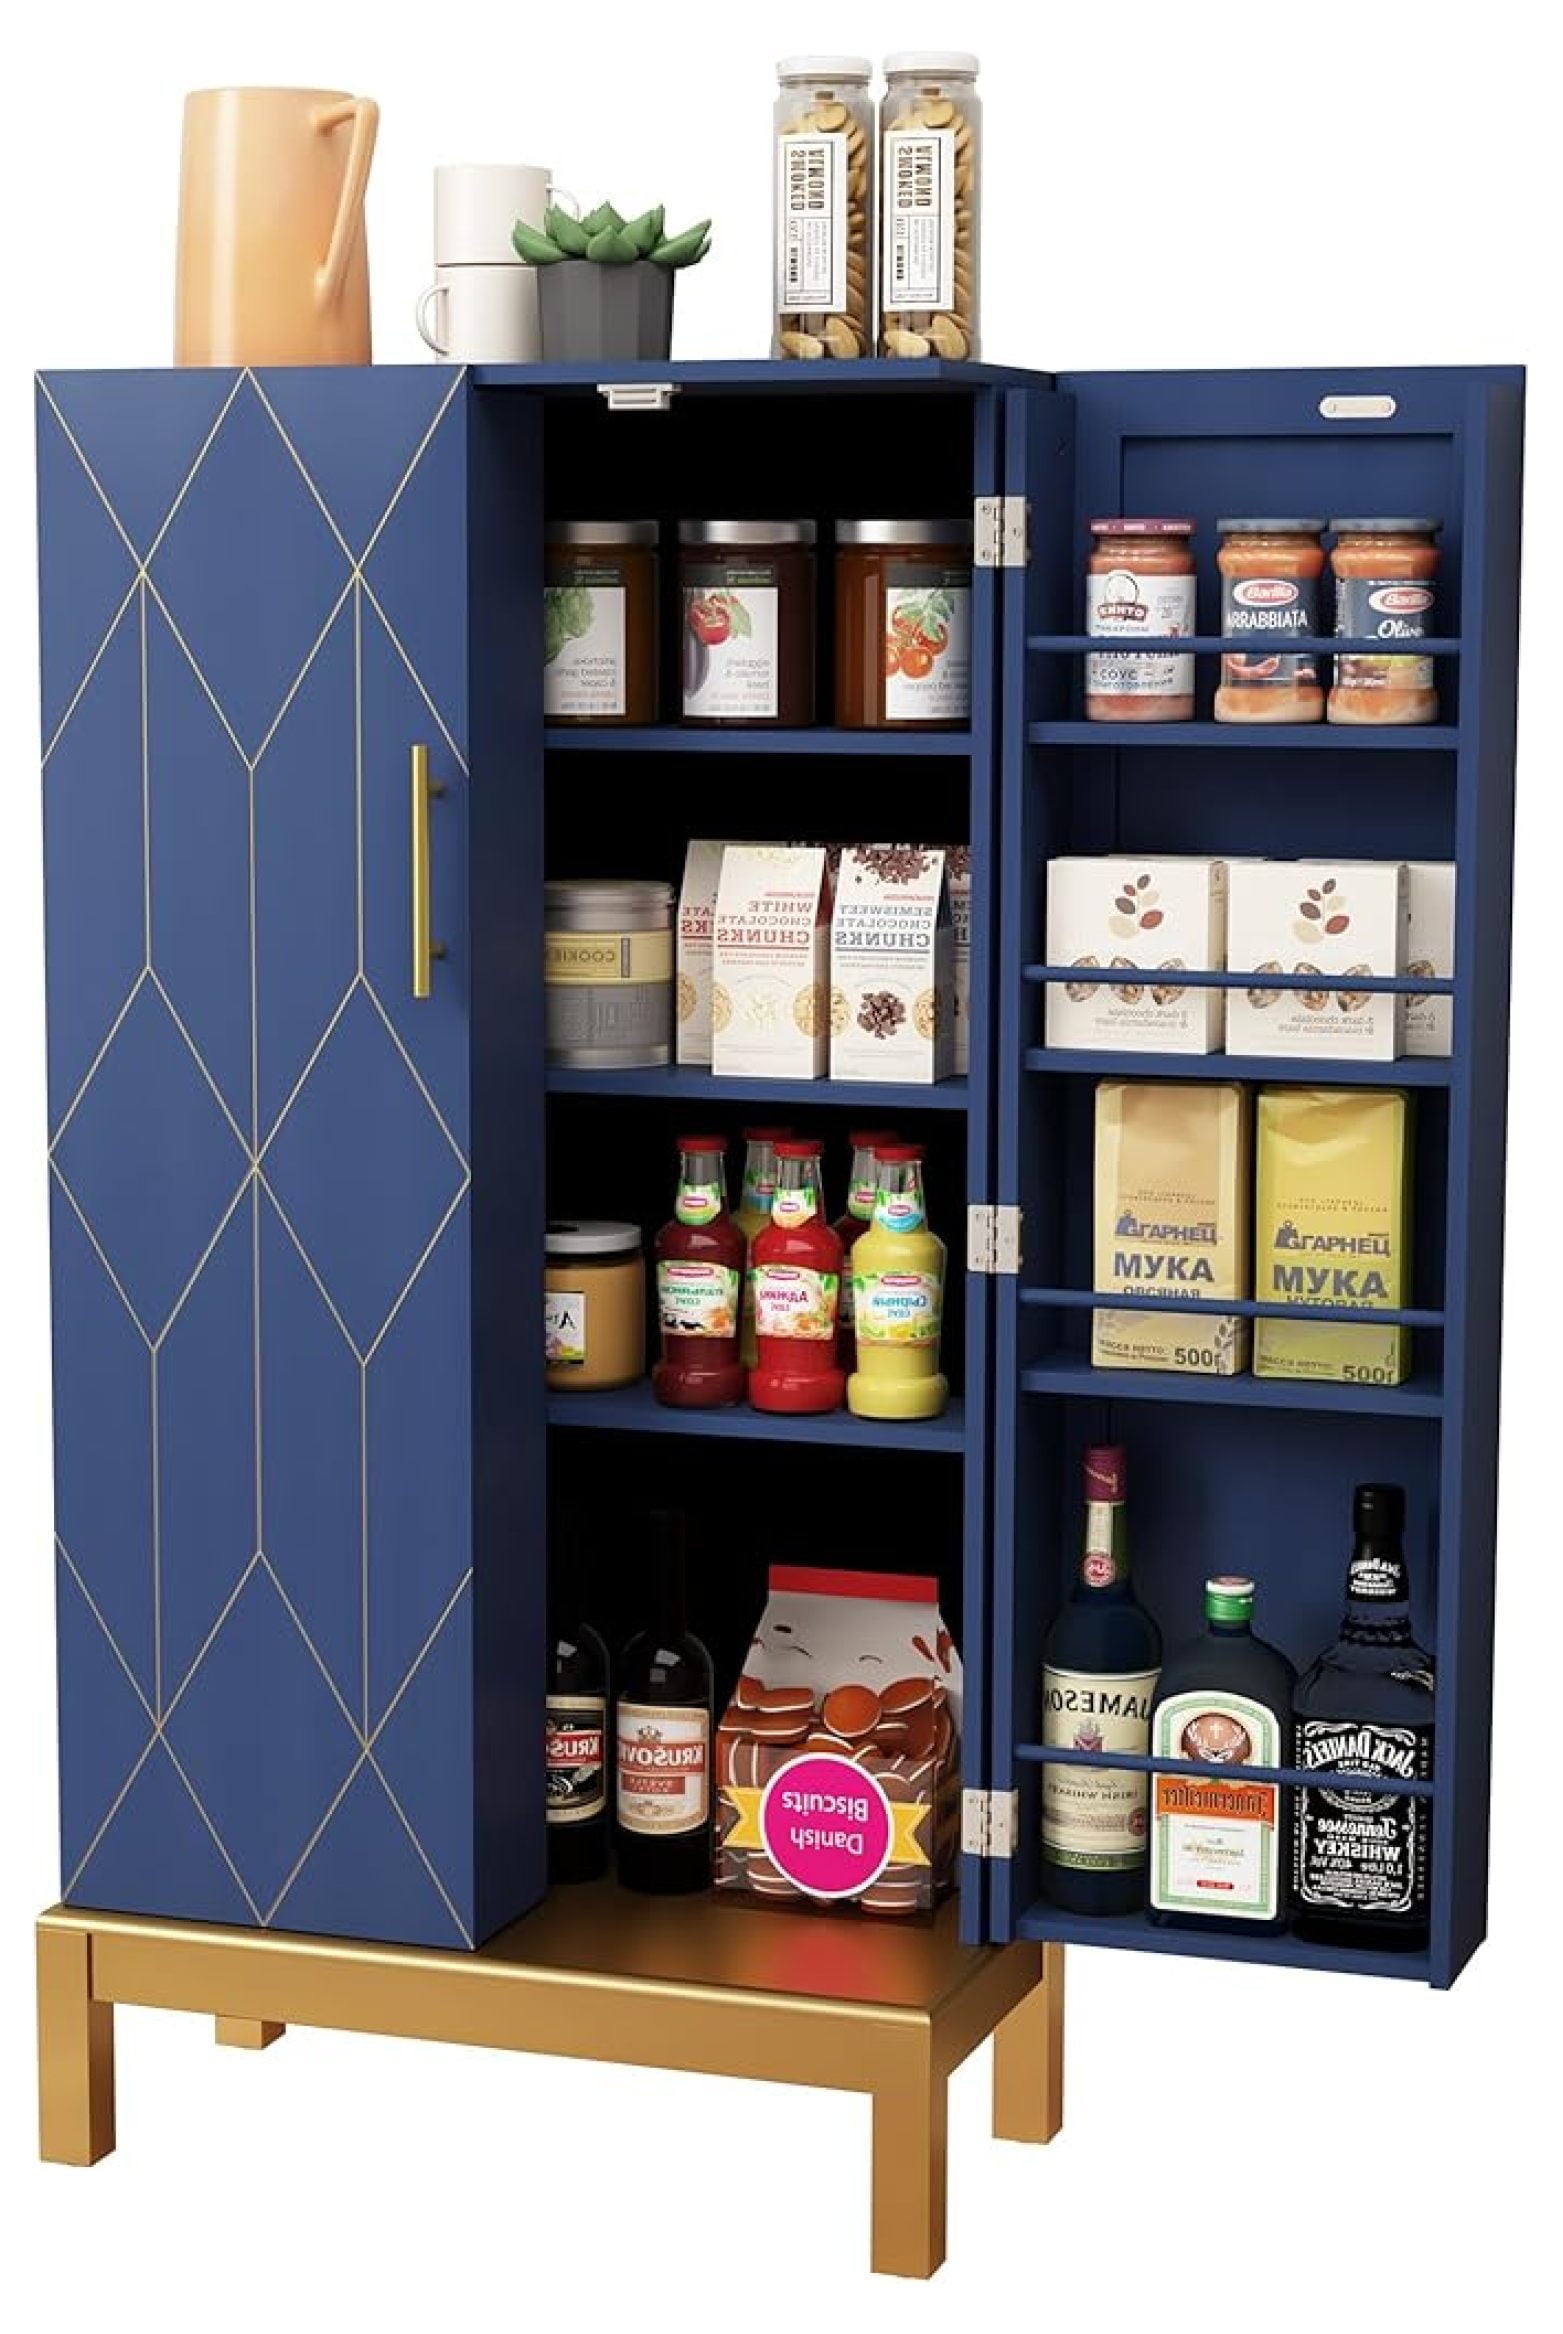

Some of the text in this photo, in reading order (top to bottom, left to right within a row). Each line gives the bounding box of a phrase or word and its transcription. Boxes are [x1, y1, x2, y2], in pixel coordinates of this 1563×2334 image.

[1140, 1223, 1217, 1246] ГАРНЕЦ
[1301, 1234, 1390, 1258] ГАРНЕЦ
[1114, 1250, 1215, 1283] МУКА
[1273, 1264, 1390, 1299] МУКА
[782, 1791, 869, 1822] Biscuits
[790, 1827, 864, 1856] Danish
